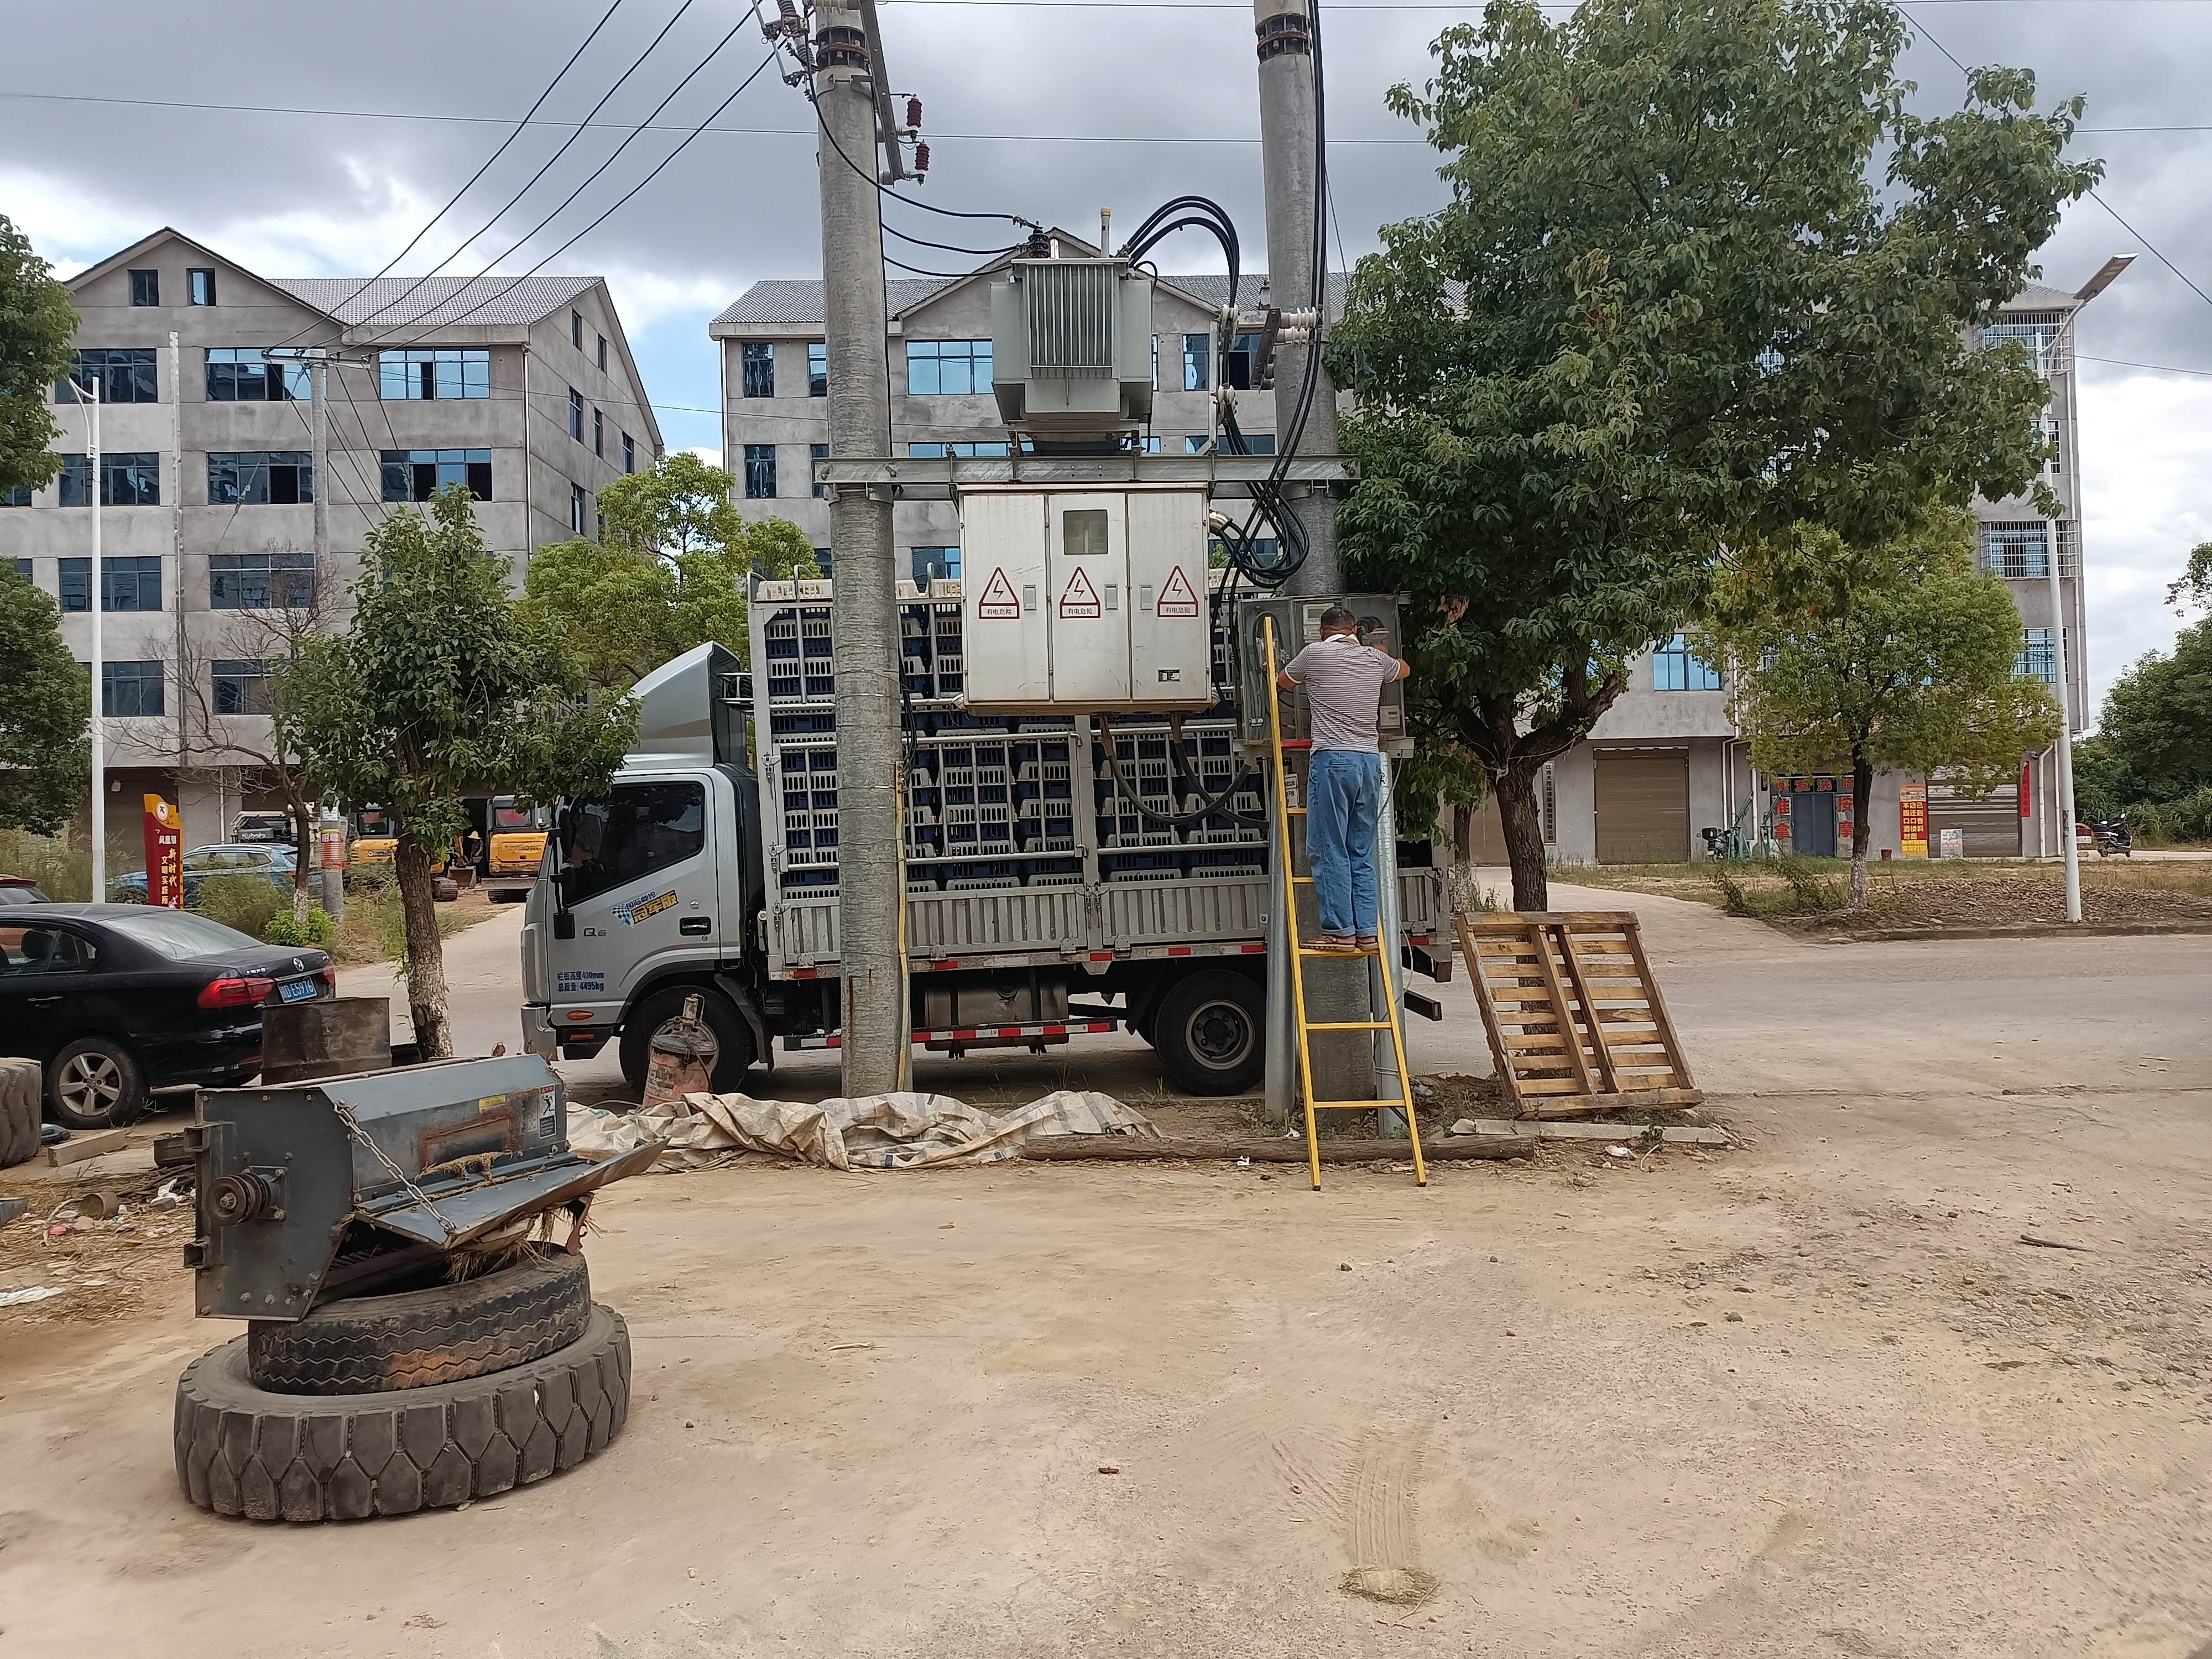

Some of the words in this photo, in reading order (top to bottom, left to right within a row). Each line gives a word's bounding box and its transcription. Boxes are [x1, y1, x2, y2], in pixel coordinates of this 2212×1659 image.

[1837, 797, 1853, 838] 按摩
[169, 848, 177, 887] 新时代
[633, 891, 678, 923] 冠军版
[583, 927, 606, 937] Q6
